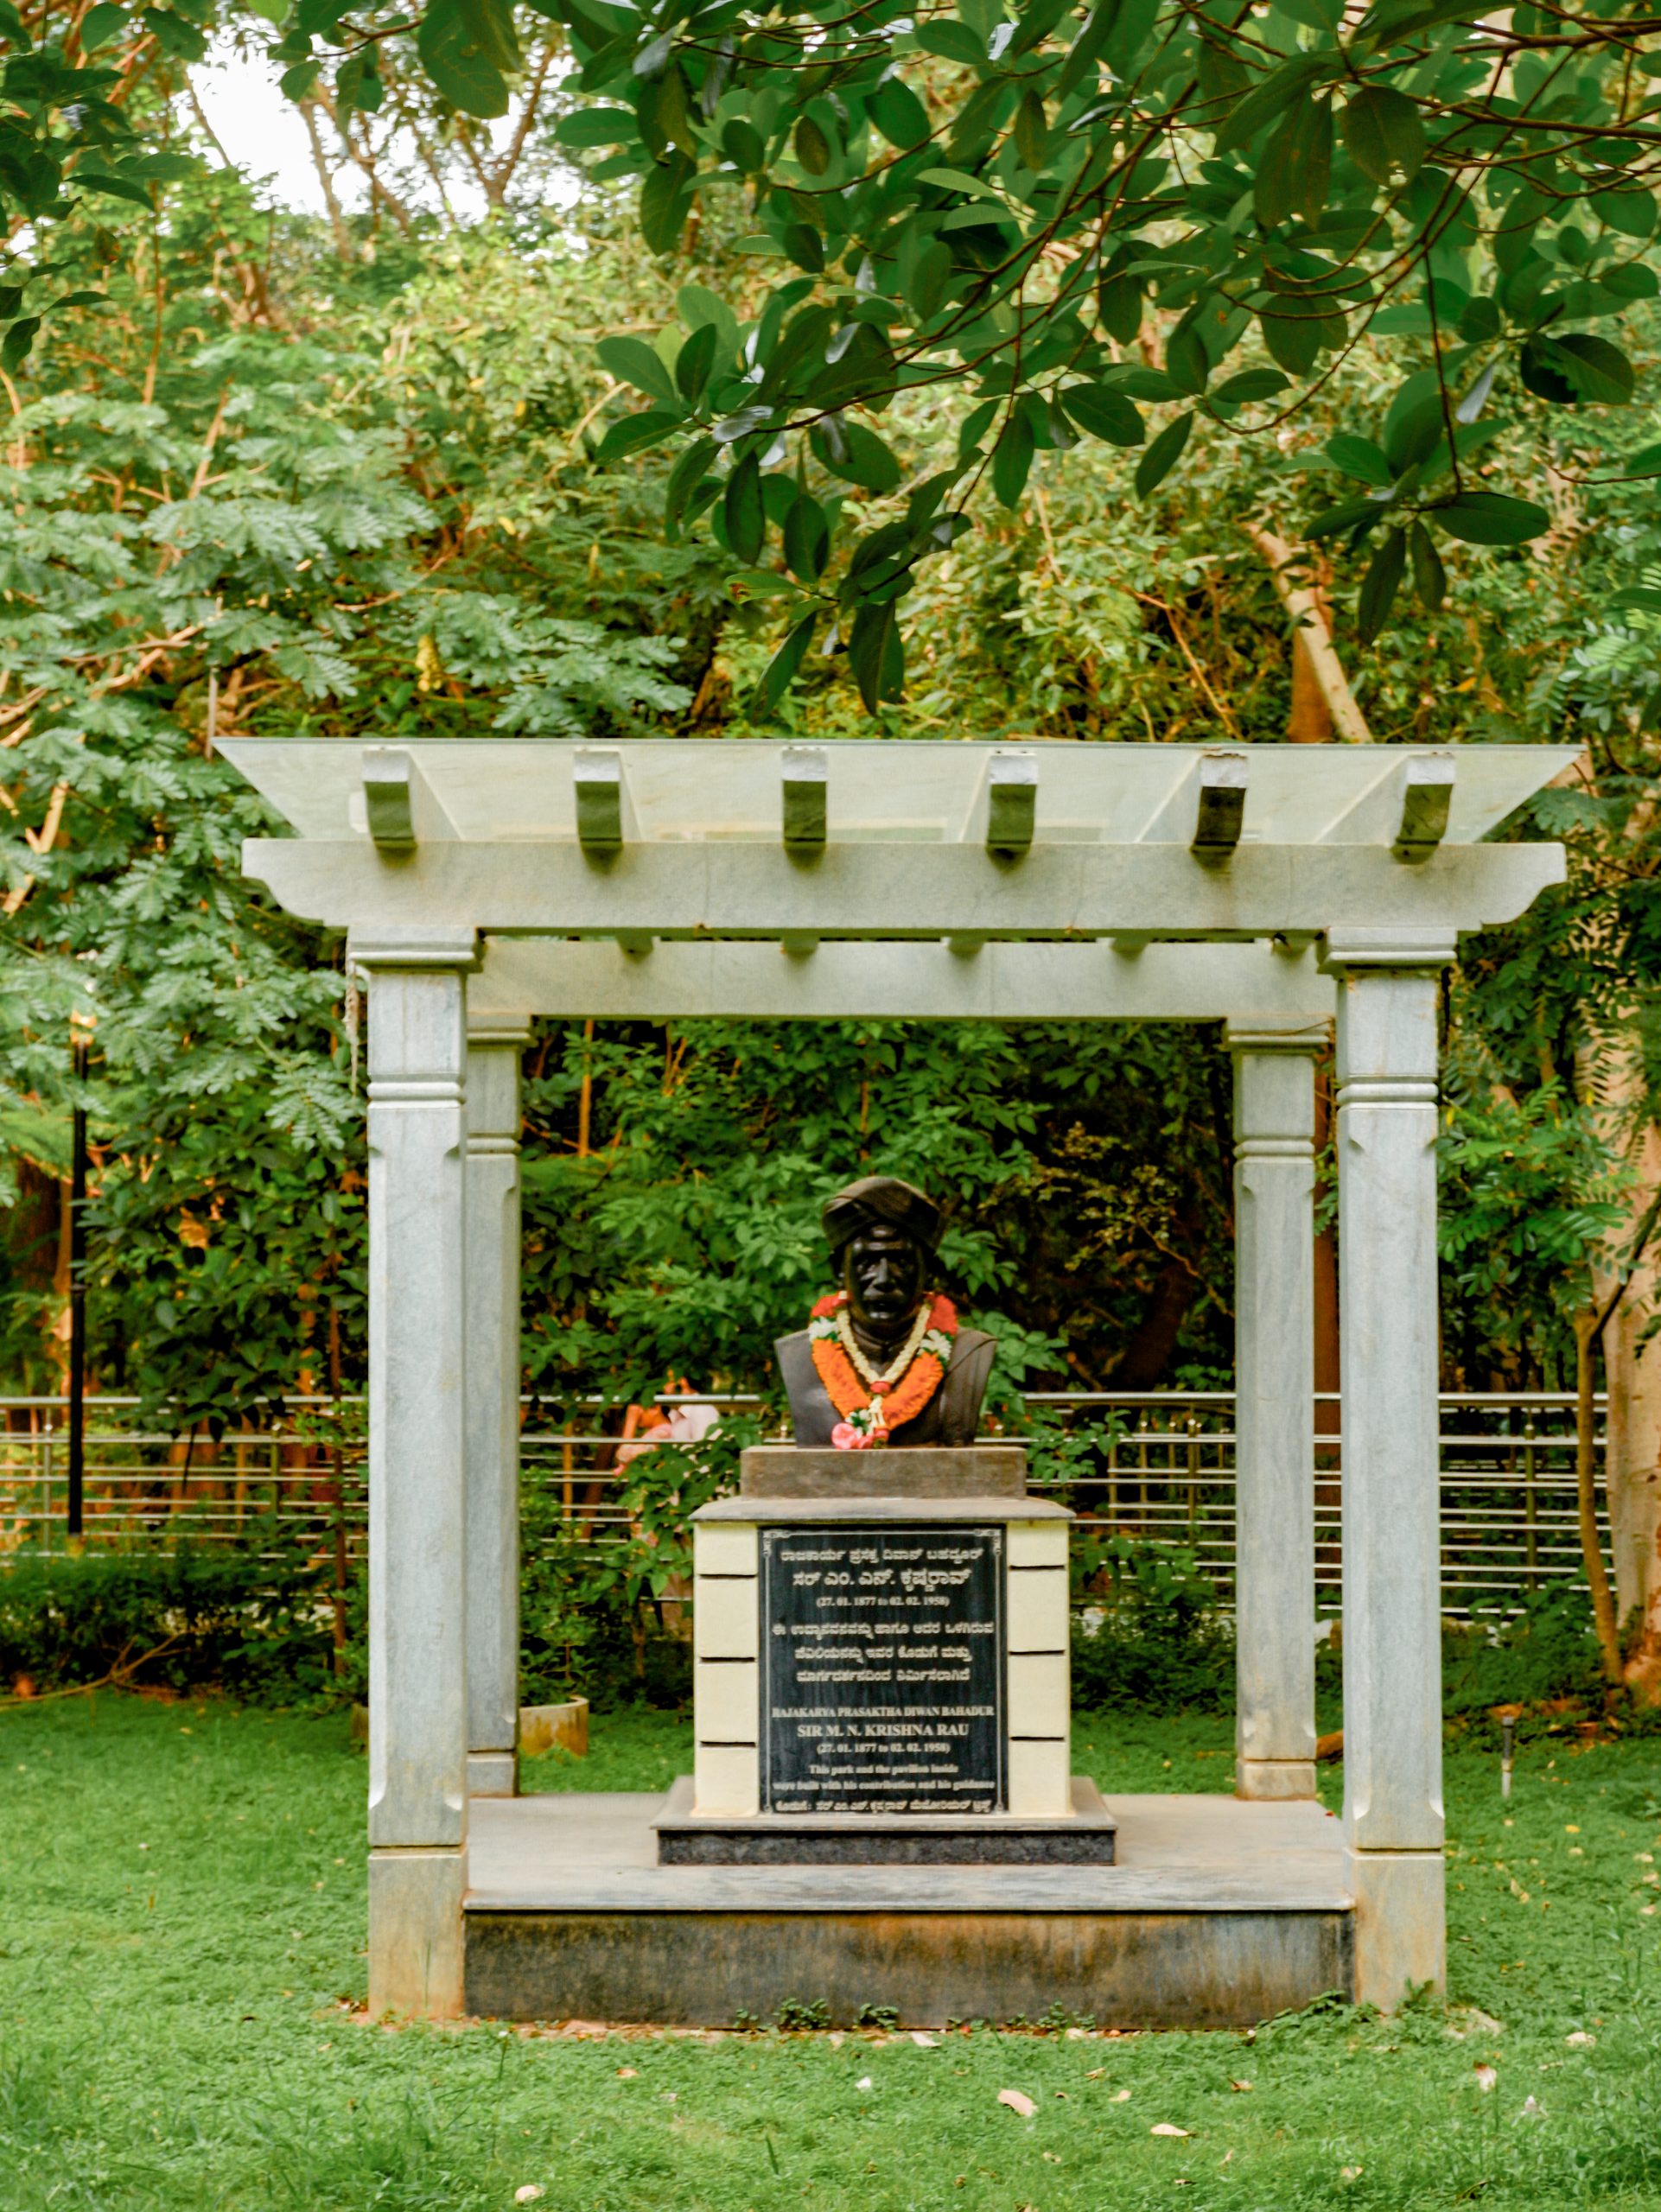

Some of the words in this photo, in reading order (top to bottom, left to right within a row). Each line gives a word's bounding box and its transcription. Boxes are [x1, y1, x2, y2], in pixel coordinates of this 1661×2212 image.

[793, 1572, 821, 1586] ಸರ್
[901, 1568, 971, 1592] ಕೃಷ್ಣರಾವ್
[771, 1707, 837, 1718] RAJAKARYA
[837, 1707, 902, 1717] PRASAKTHA
[904, 1707, 939, 1716] DIWAN
[942, 1707, 994, 1716] BAHADUR
[798, 1725, 824, 1737] SIR
[824, 1725, 844, 1738] M.
[847, 1725, 862, 1736] N.
[865, 1725, 933, 1736] KRISHNA
[937, 1724, 968, 1735] RAU
[855, 1744, 876, 1752] 1877
[809, 1764, 830, 1774] This
